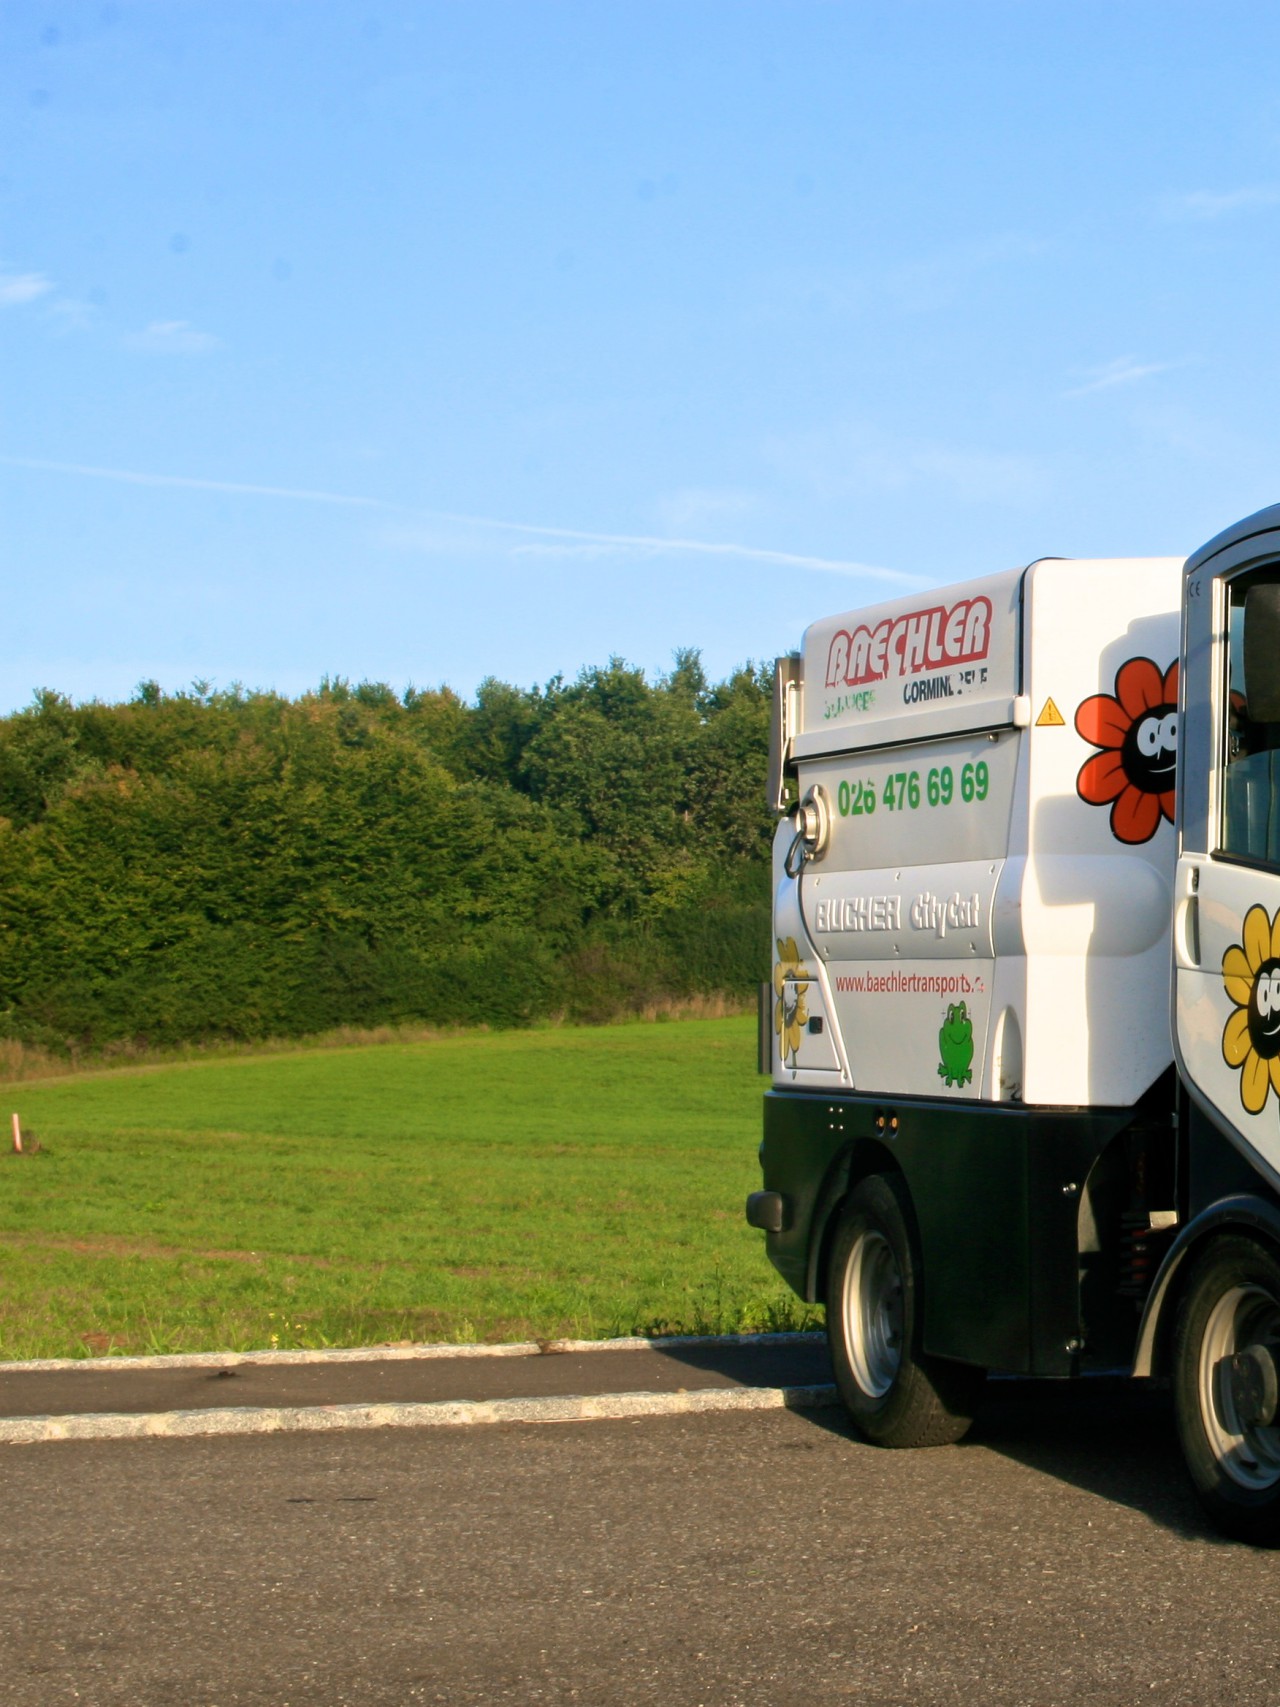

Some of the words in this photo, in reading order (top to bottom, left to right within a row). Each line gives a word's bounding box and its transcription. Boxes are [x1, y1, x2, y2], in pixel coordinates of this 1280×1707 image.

[825, 595, 993, 688] BAECHLER
[838, 778, 877, 817] 026
[883, 771, 921, 810] 476
[927, 766, 954, 807] 69
[961, 761, 990, 803] 69
[816, 895, 901, 933] BUCHER
